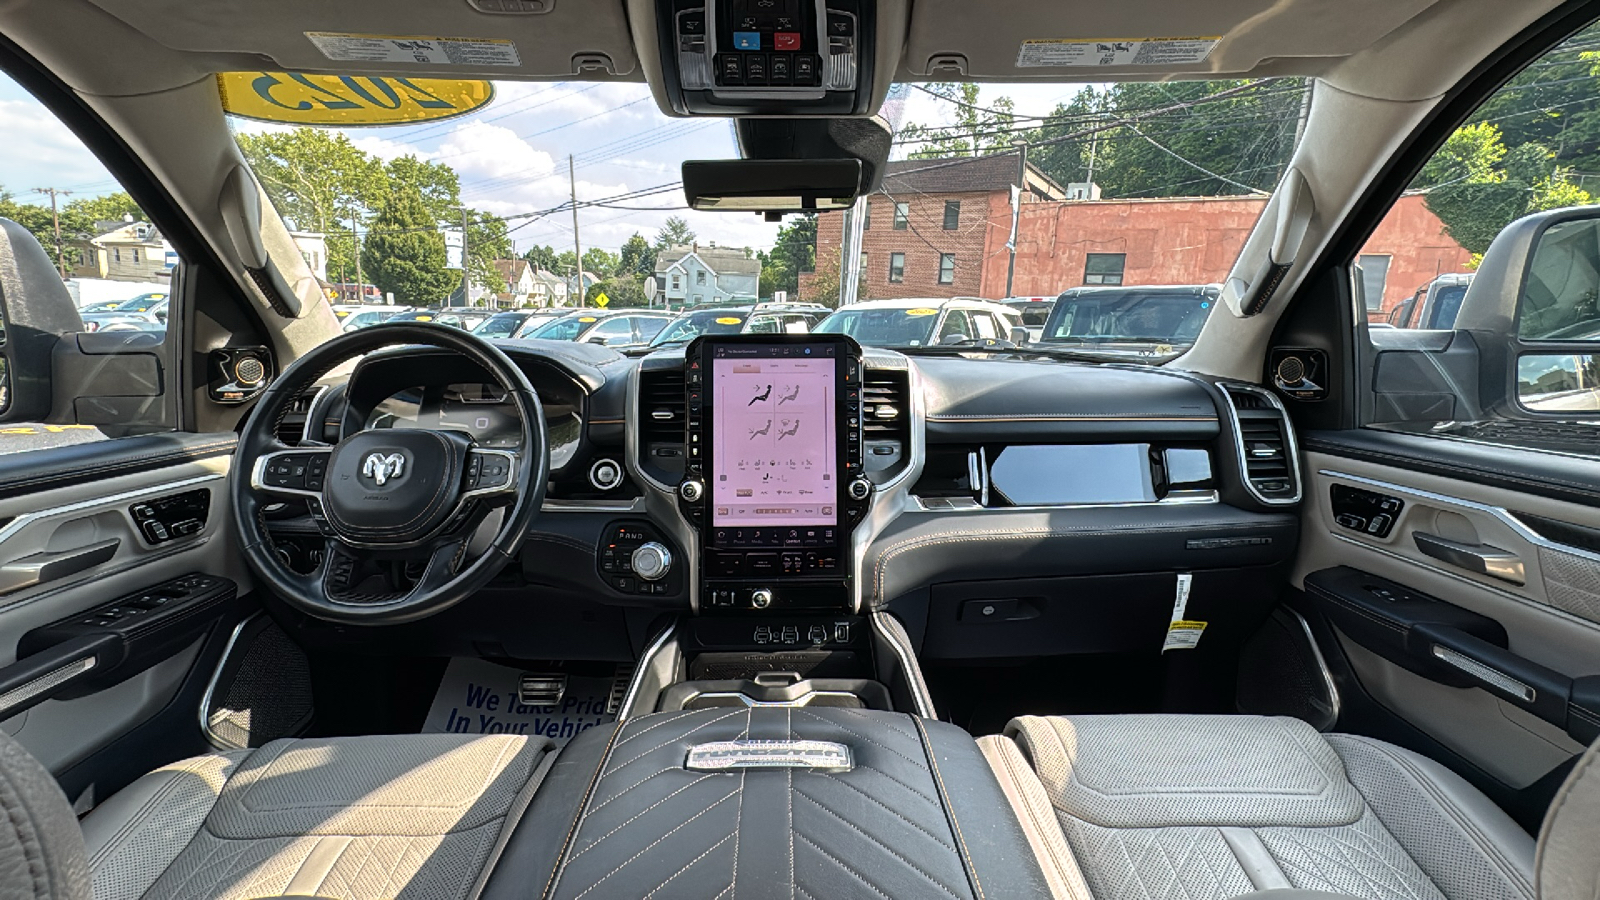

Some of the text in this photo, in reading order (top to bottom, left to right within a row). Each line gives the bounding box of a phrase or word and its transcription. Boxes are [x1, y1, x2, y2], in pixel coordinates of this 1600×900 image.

[466, 683, 499, 711] We
[561, 696, 607, 715] Prid
[446, 708, 602, 738] In Your Vehi
